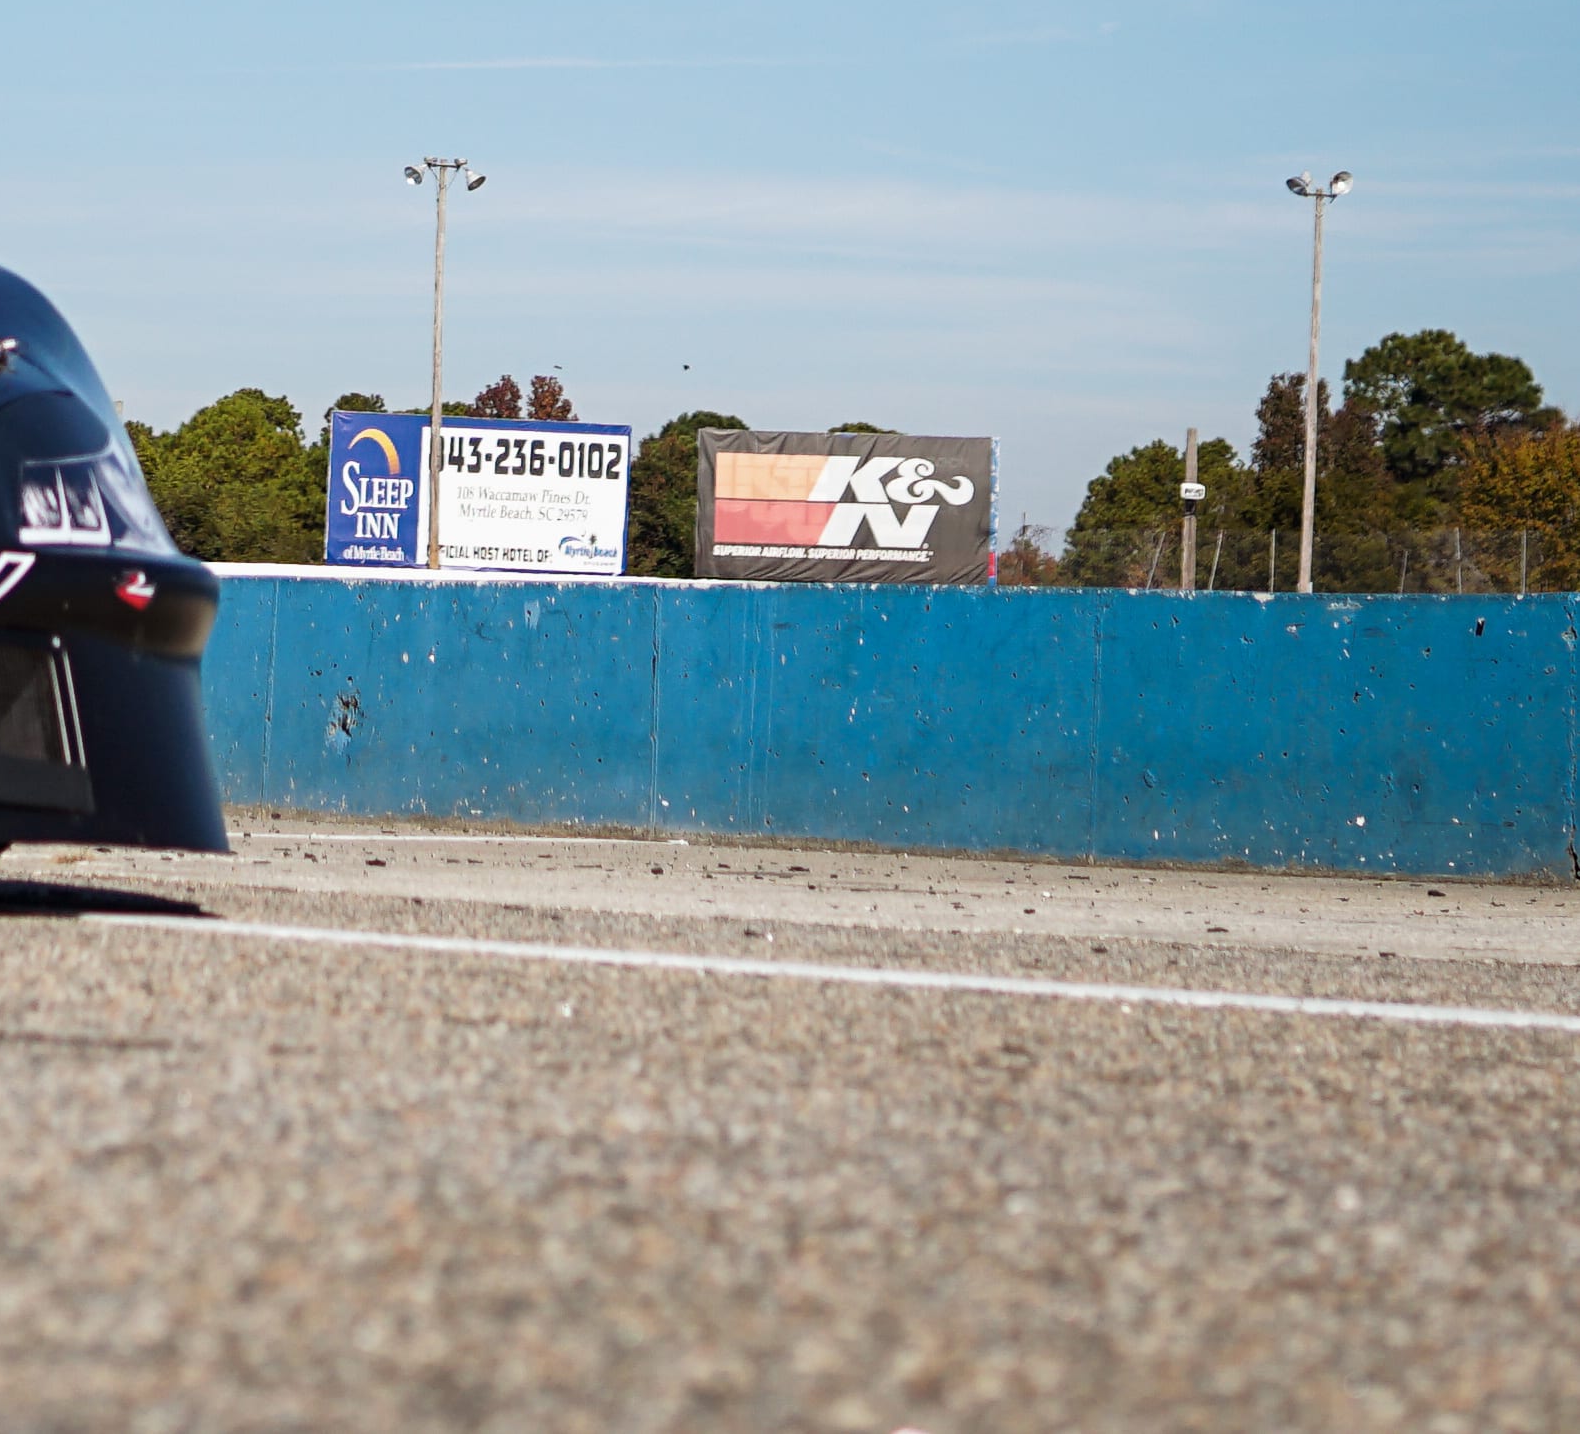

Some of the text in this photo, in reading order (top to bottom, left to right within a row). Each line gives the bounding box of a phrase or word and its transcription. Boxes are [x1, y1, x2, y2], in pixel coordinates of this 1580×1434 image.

[341, 460, 414, 516] SLEEP
[542, 489, 572, 505] Pines
[459, 503, 498, 519] Myrtle
[538, 507, 554, 522] SC
[354, 511, 401, 540] INN
[473, 546, 499, 561] HOST
[502, 547, 534, 563] HOTEL
[712, 545, 762, 558] SUPERIOR
[807, 548, 856, 560] SUPERIOR
